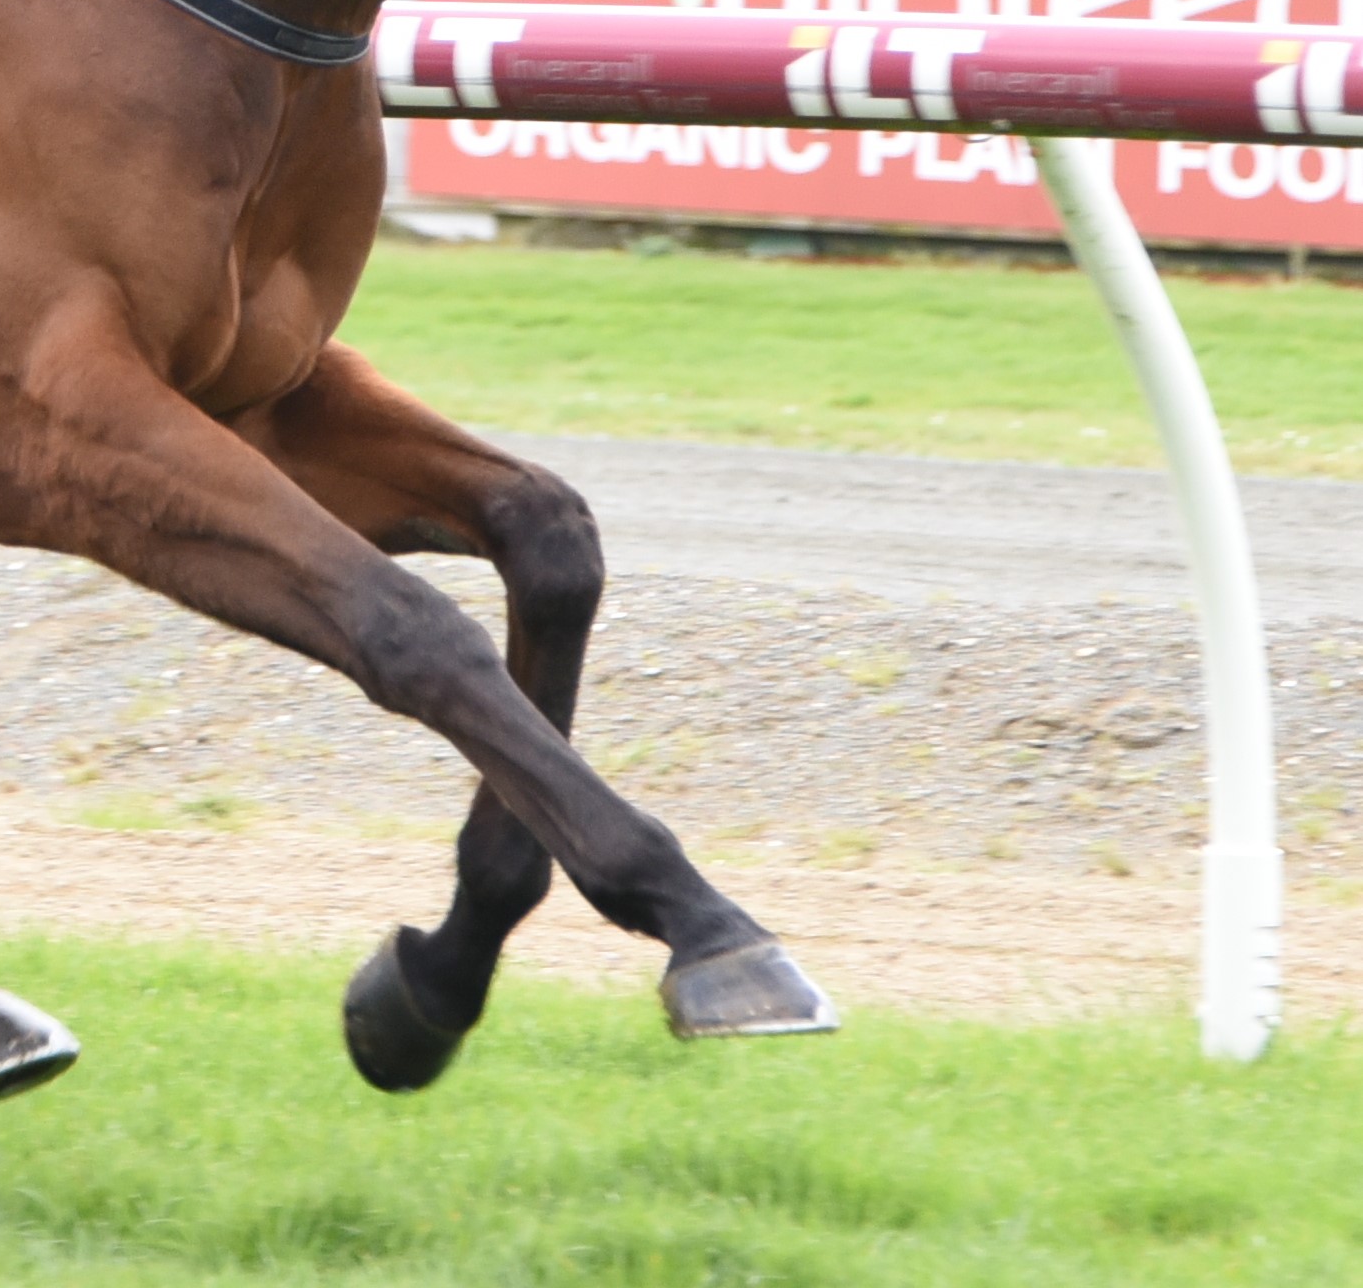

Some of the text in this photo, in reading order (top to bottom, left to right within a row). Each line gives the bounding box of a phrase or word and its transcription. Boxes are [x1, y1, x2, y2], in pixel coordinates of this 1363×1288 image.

[375, 15, 527, 108] LT
[1253, 40, 1363, 136] IL
[859, 129, 1115, 186] PLA
[1157, 140, 1363, 204] FOO
